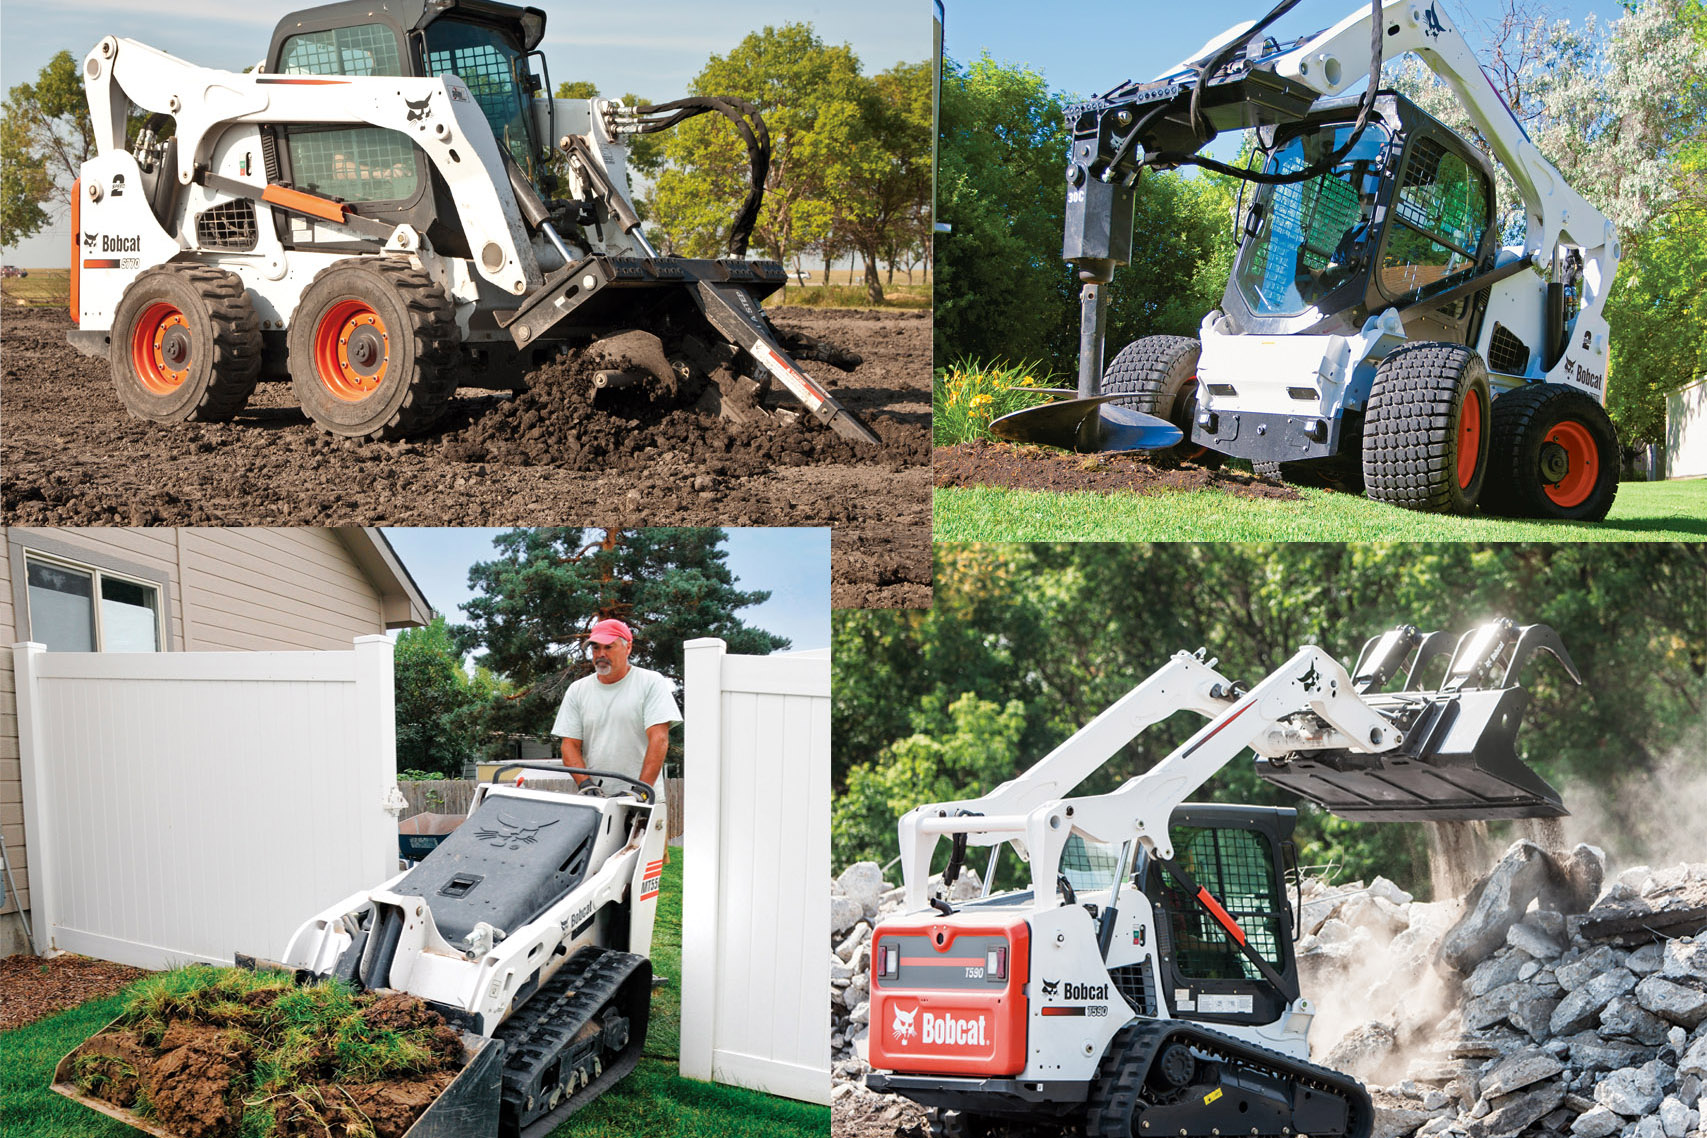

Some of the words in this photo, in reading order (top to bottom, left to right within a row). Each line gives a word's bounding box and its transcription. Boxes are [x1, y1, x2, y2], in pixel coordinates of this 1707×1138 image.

[111, 174, 124, 196] 2
[1068, 190, 1085, 203] 30C
[102, 234, 141, 252] Bobcat
[121, 258, 140, 270] S770
[1582, 330, 1592, 351] 2
[1576, 364, 1602, 391] Bobcat
[571, 900, 592, 928] Bobcat
[965, 967, 984, 979] T590
[1064, 983, 1109, 1001] Bobcat
[1087, 1006, 1109, 1017] T590
[922, 1013, 986, 1046] Bobcat
